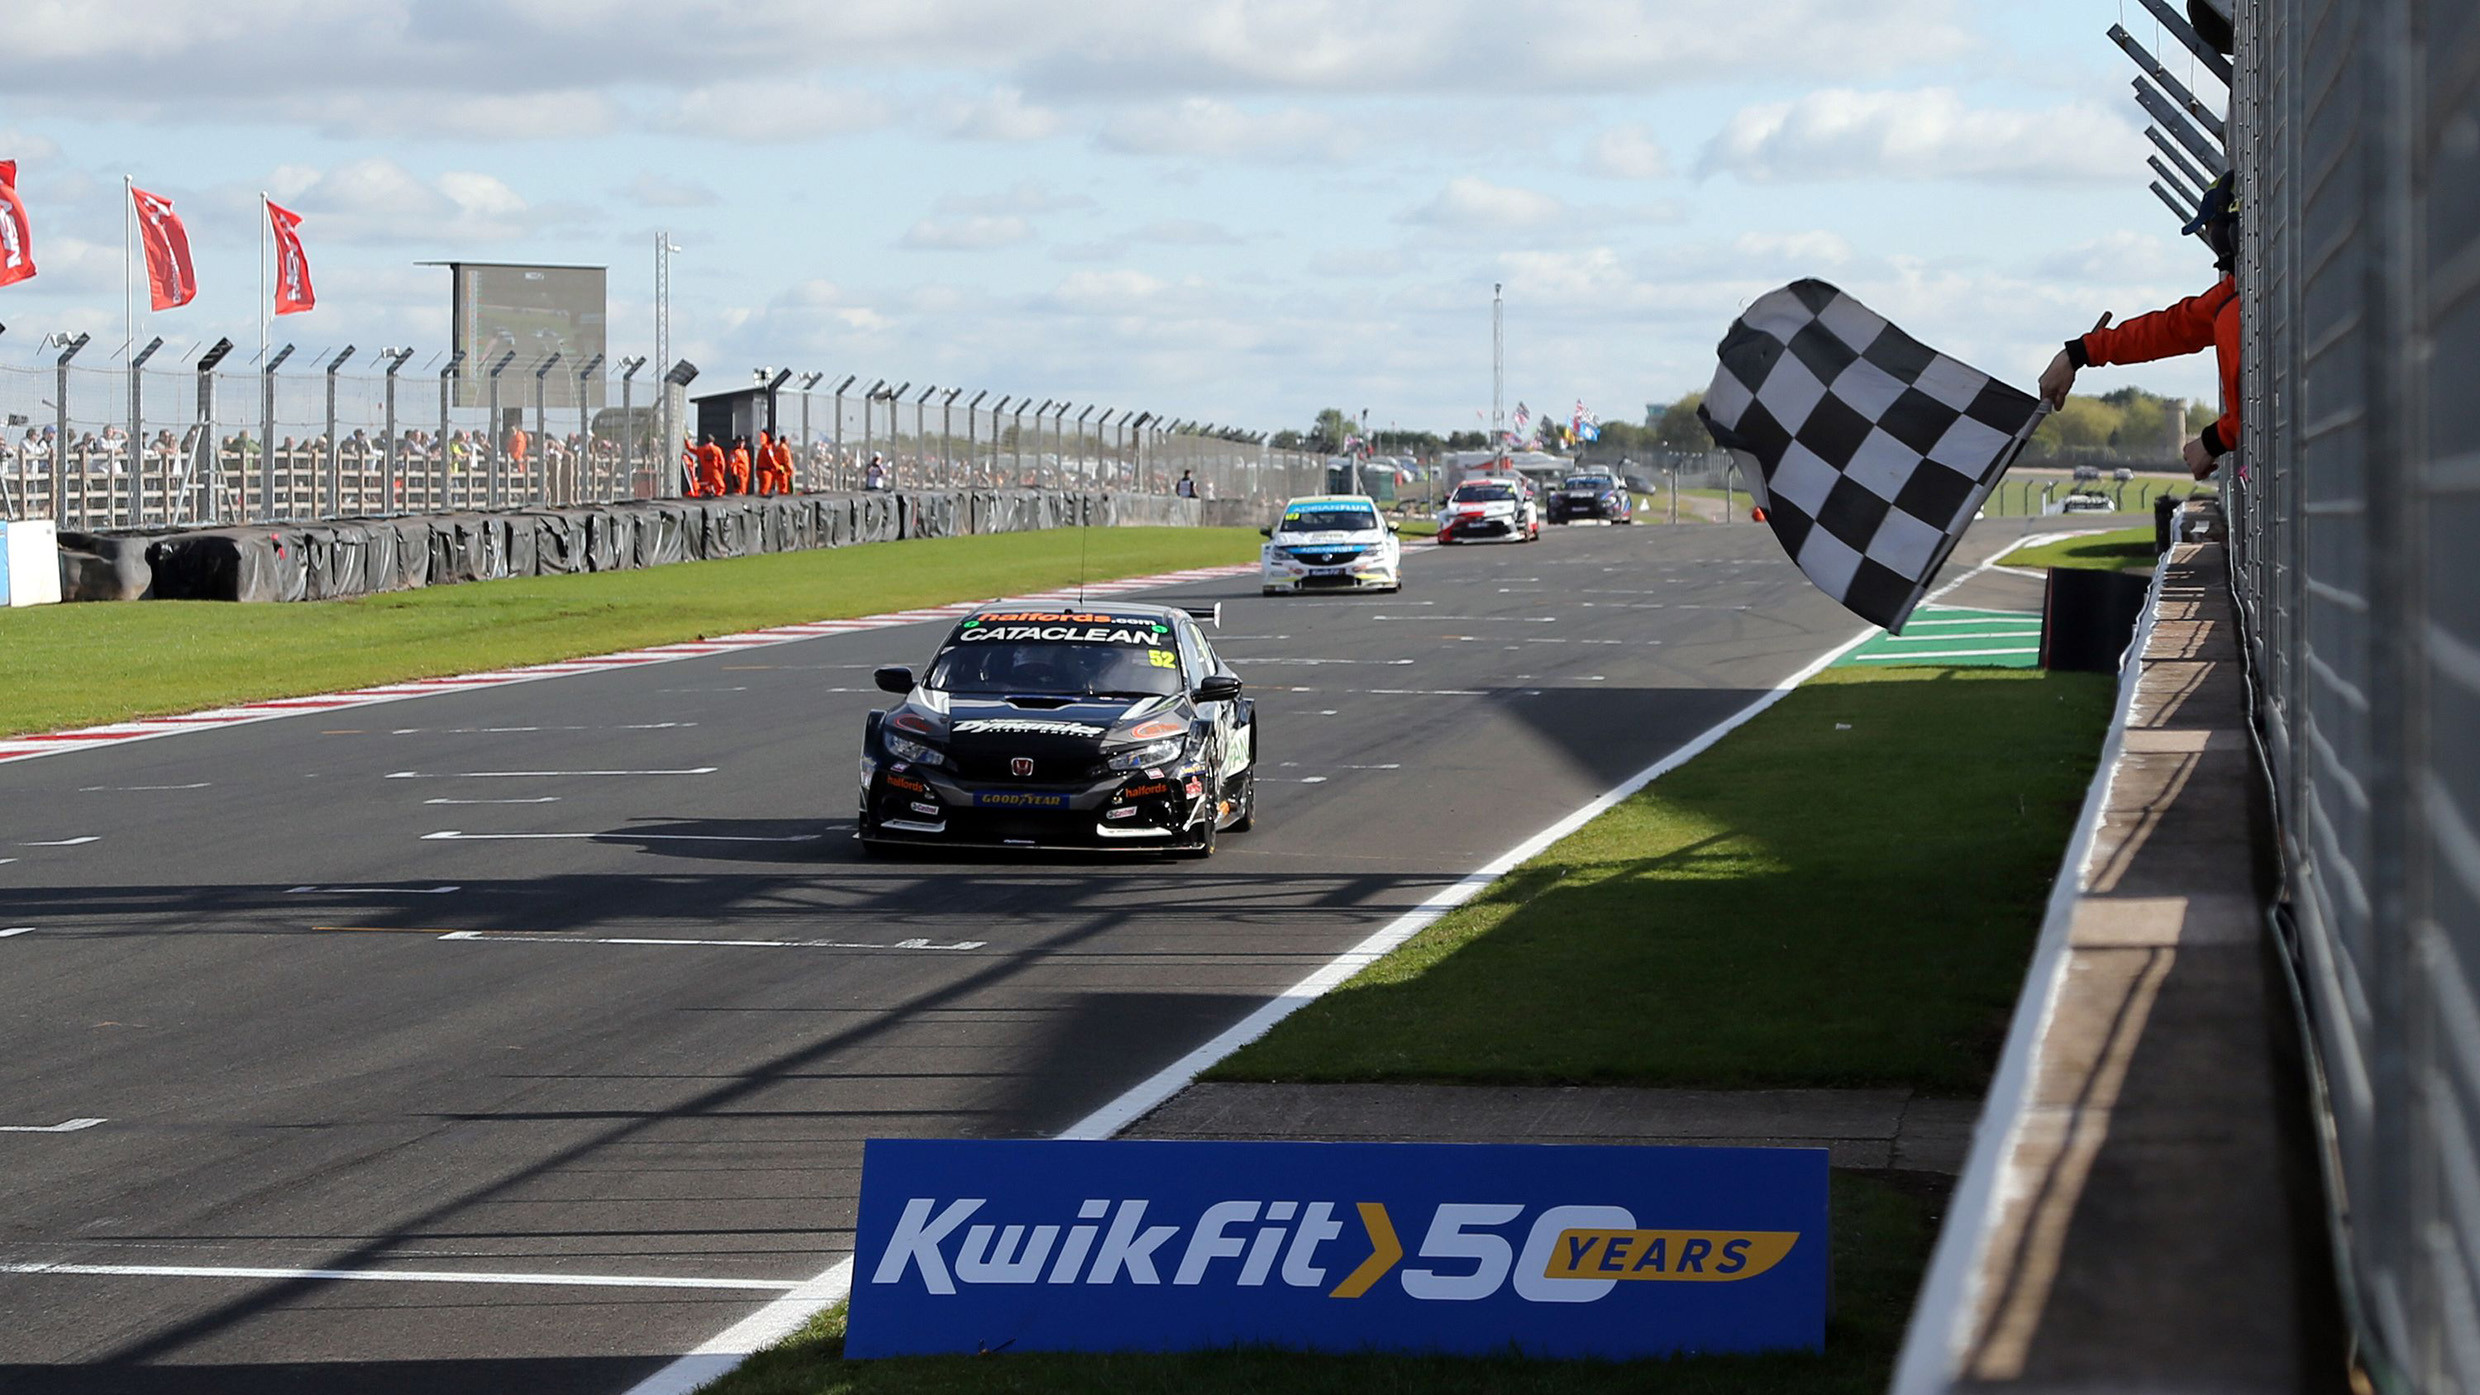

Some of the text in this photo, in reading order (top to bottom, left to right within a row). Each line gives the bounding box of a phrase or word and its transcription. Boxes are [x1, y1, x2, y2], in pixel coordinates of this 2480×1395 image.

[977, 612, 1157, 626] halfords.com
[960, 626, 1162, 645] CATACLEAN
[1147, 649, 1177, 669] 52
[952, 718, 1105, 735] Dynamics
[886, 775, 924, 792] halfords
[1125, 783, 1168, 799] halfords
[1401, 1203, 1638, 1303] 50
[1561, 1234, 1752, 1275] YEARS
